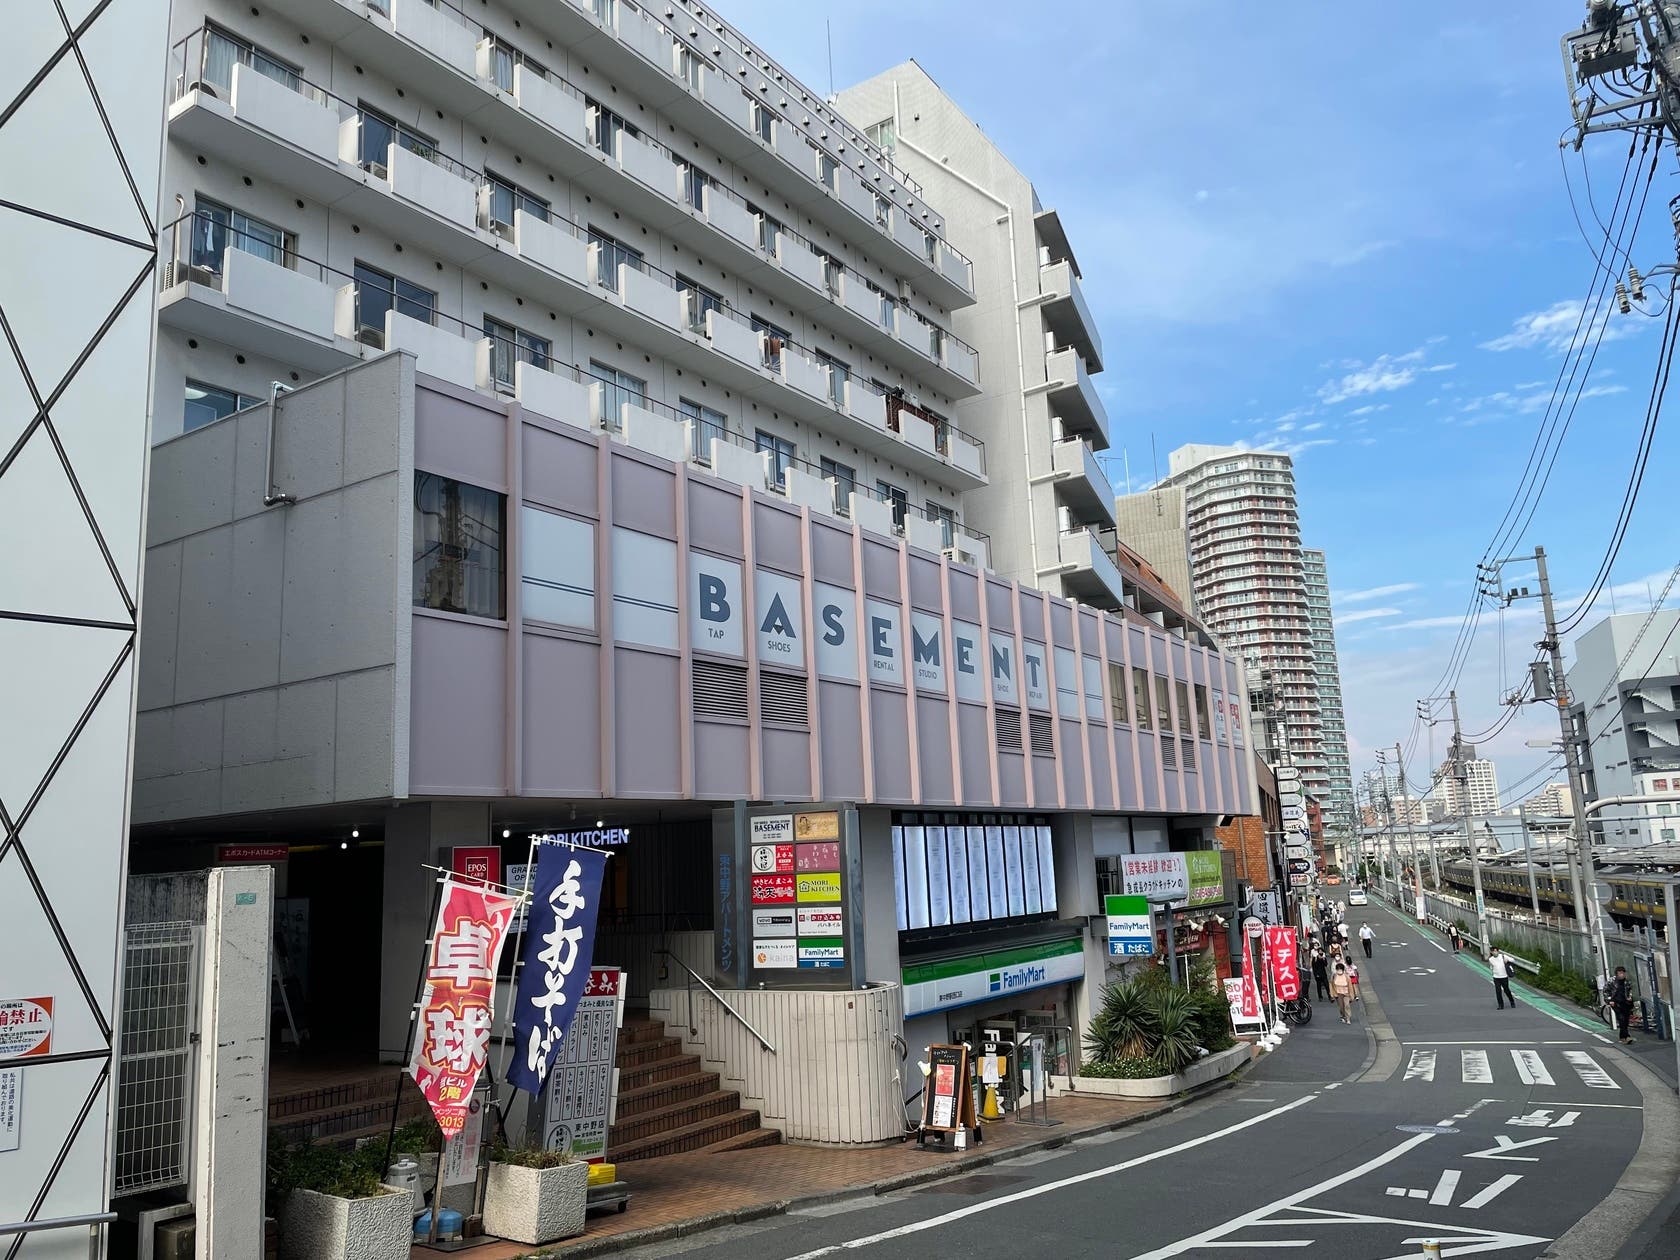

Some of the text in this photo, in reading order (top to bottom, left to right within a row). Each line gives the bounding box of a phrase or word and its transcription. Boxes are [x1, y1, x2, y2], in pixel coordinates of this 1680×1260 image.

[708, 628, 791, 652] TAP SHOES
[873, 660, 937, 680] RENTAL STUDIO
[754, 823, 790, 832] BASEMENT
[572, 828, 629, 846] KITCHEN
[467, 862, 487, 872] EPOS
[754, 878, 774, 886] やきとん
[1110, 922, 1150, 932] FamilyMart
[1114, 943, 1150, 954] 酒 たばこ
[1275, 931, 1298, 997] パチスロ
[1003, 966, 1046, 989] FamilyMart
[426, 917, 493, 1075] 卓球
[439, 1086, 462, 1102] 2階
[574, 1120, 605, 1132] 東中野店
